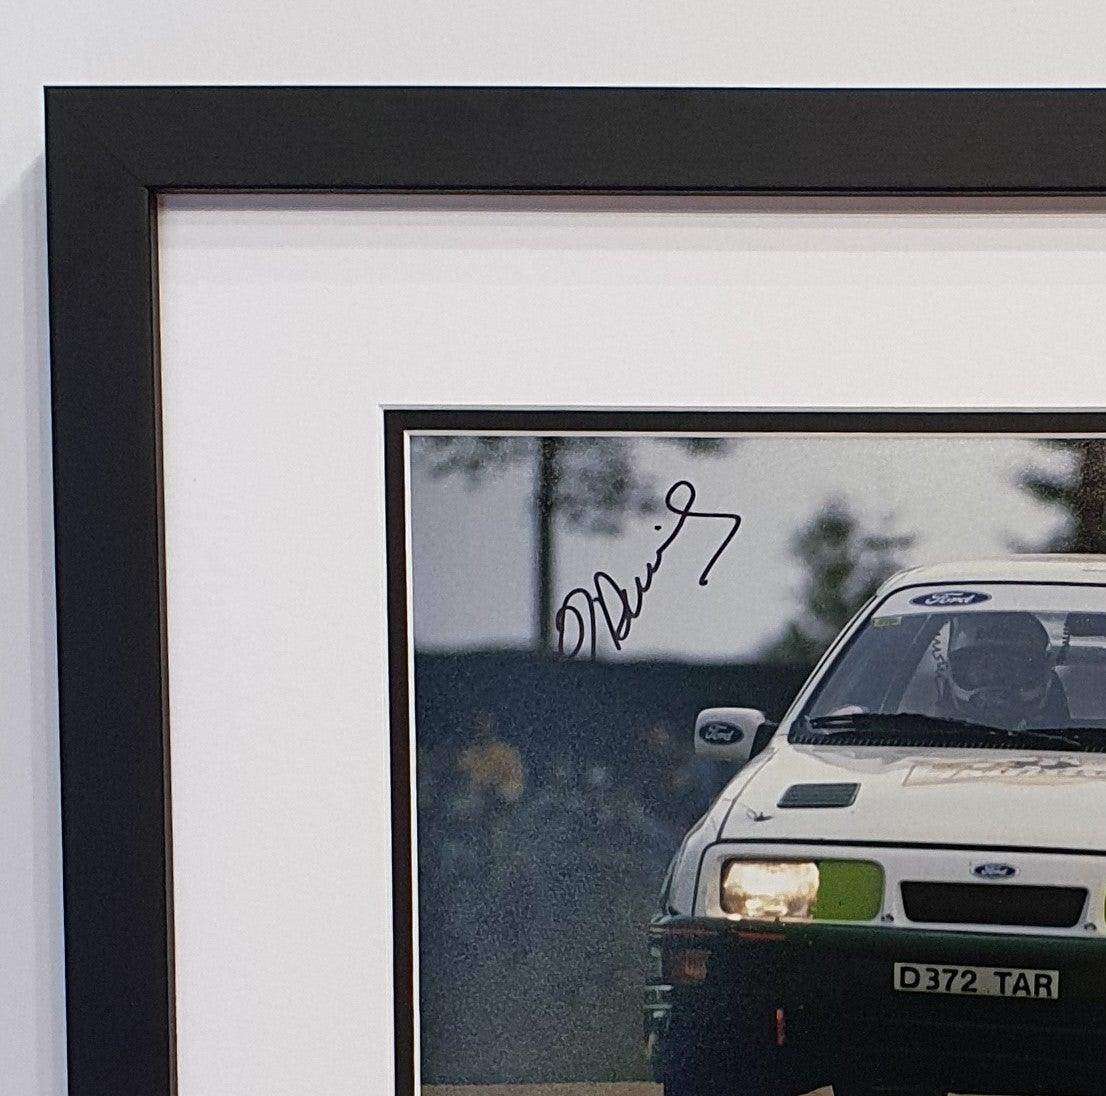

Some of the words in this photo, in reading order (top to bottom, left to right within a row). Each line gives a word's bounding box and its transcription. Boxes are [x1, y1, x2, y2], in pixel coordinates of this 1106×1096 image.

[924, 592, 976, 605] Ford
[899, 966, 978, 993] D372
[993, 971, 1054, 998] TAR
